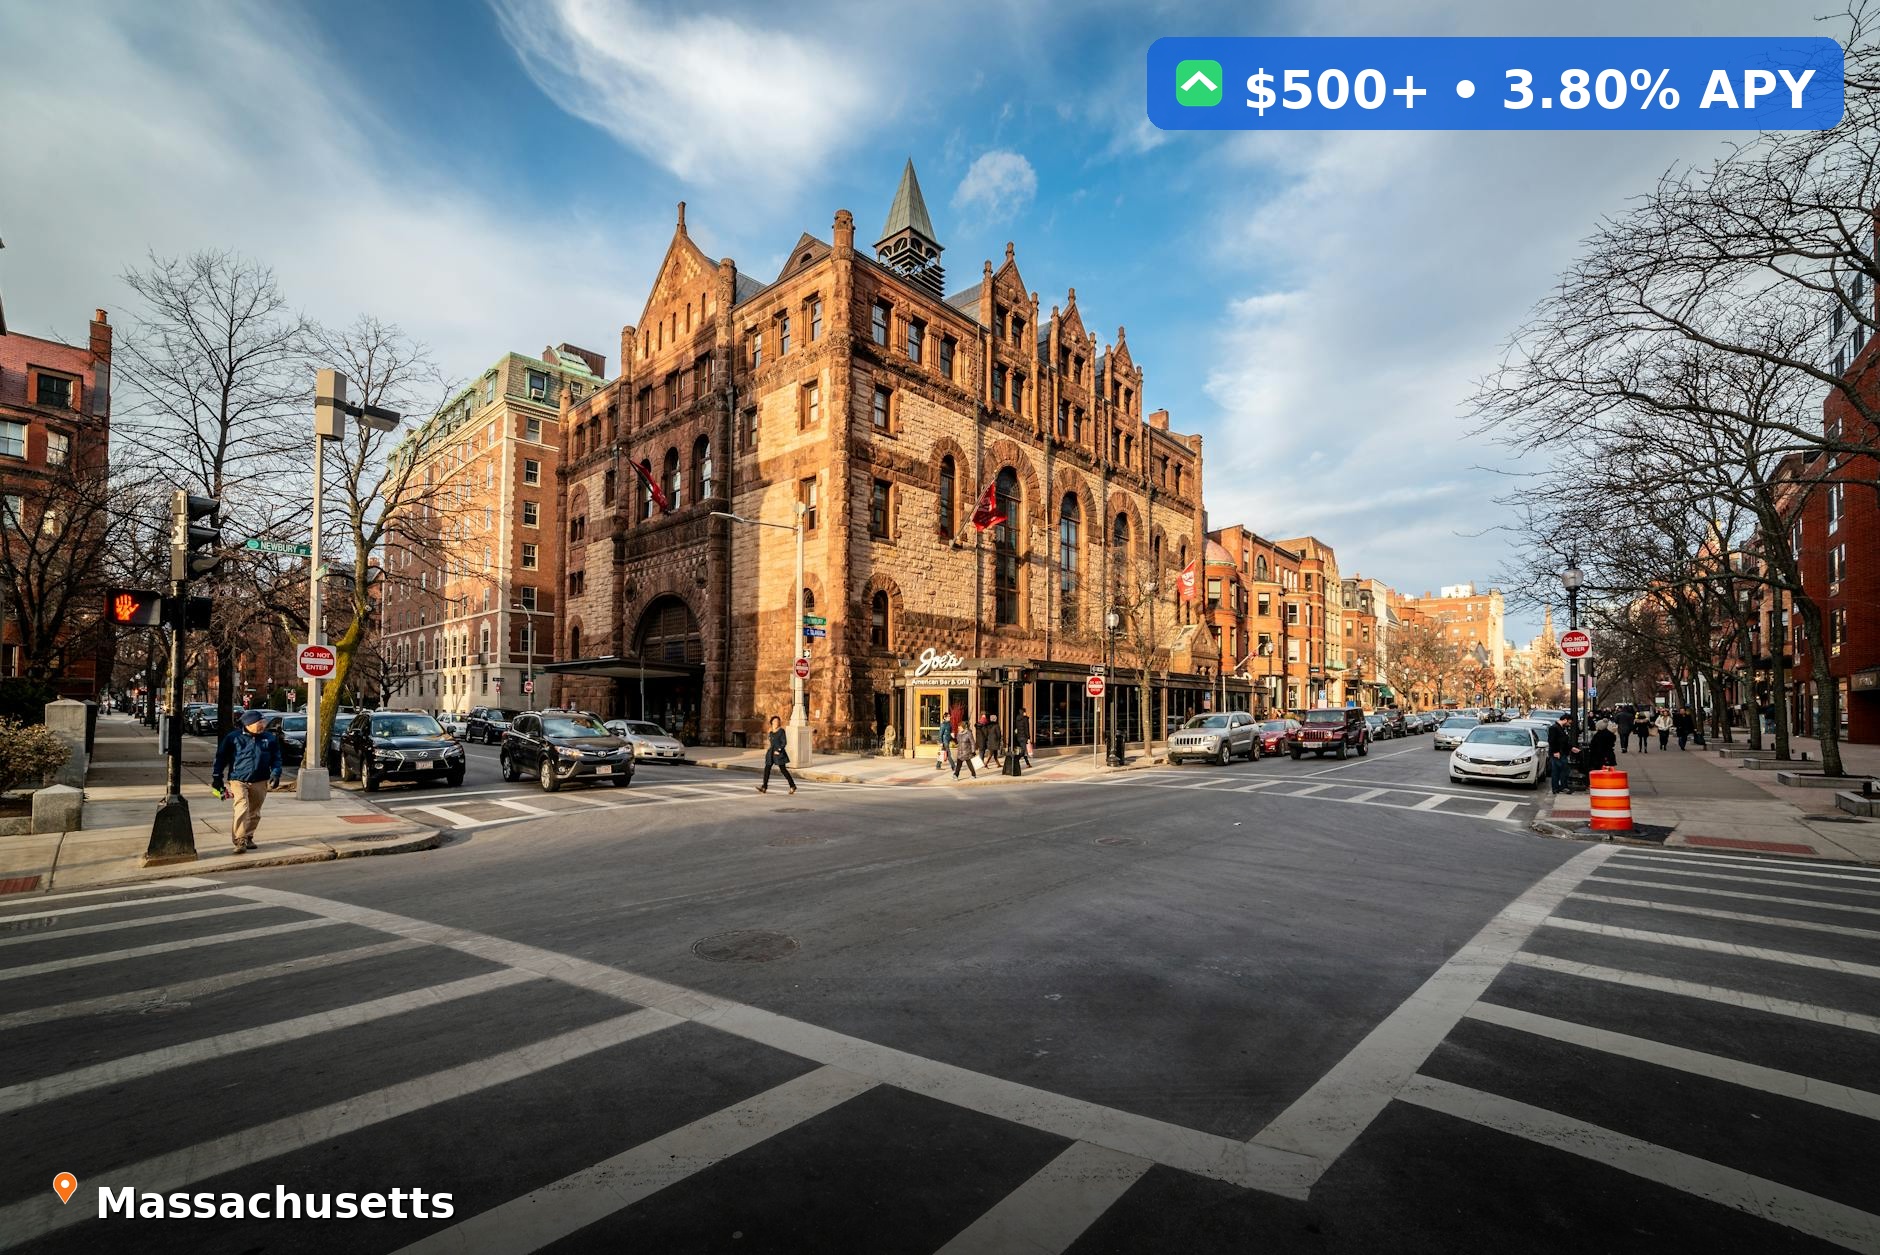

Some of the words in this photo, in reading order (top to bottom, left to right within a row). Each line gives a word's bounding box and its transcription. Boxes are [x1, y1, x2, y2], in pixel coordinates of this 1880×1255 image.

[260, 541, 298, 553] NEWBURY
[915, 647, 964, 677] Joe's
[912, 678, 939, 686] American
[939, 678, 951, 686] Bar
